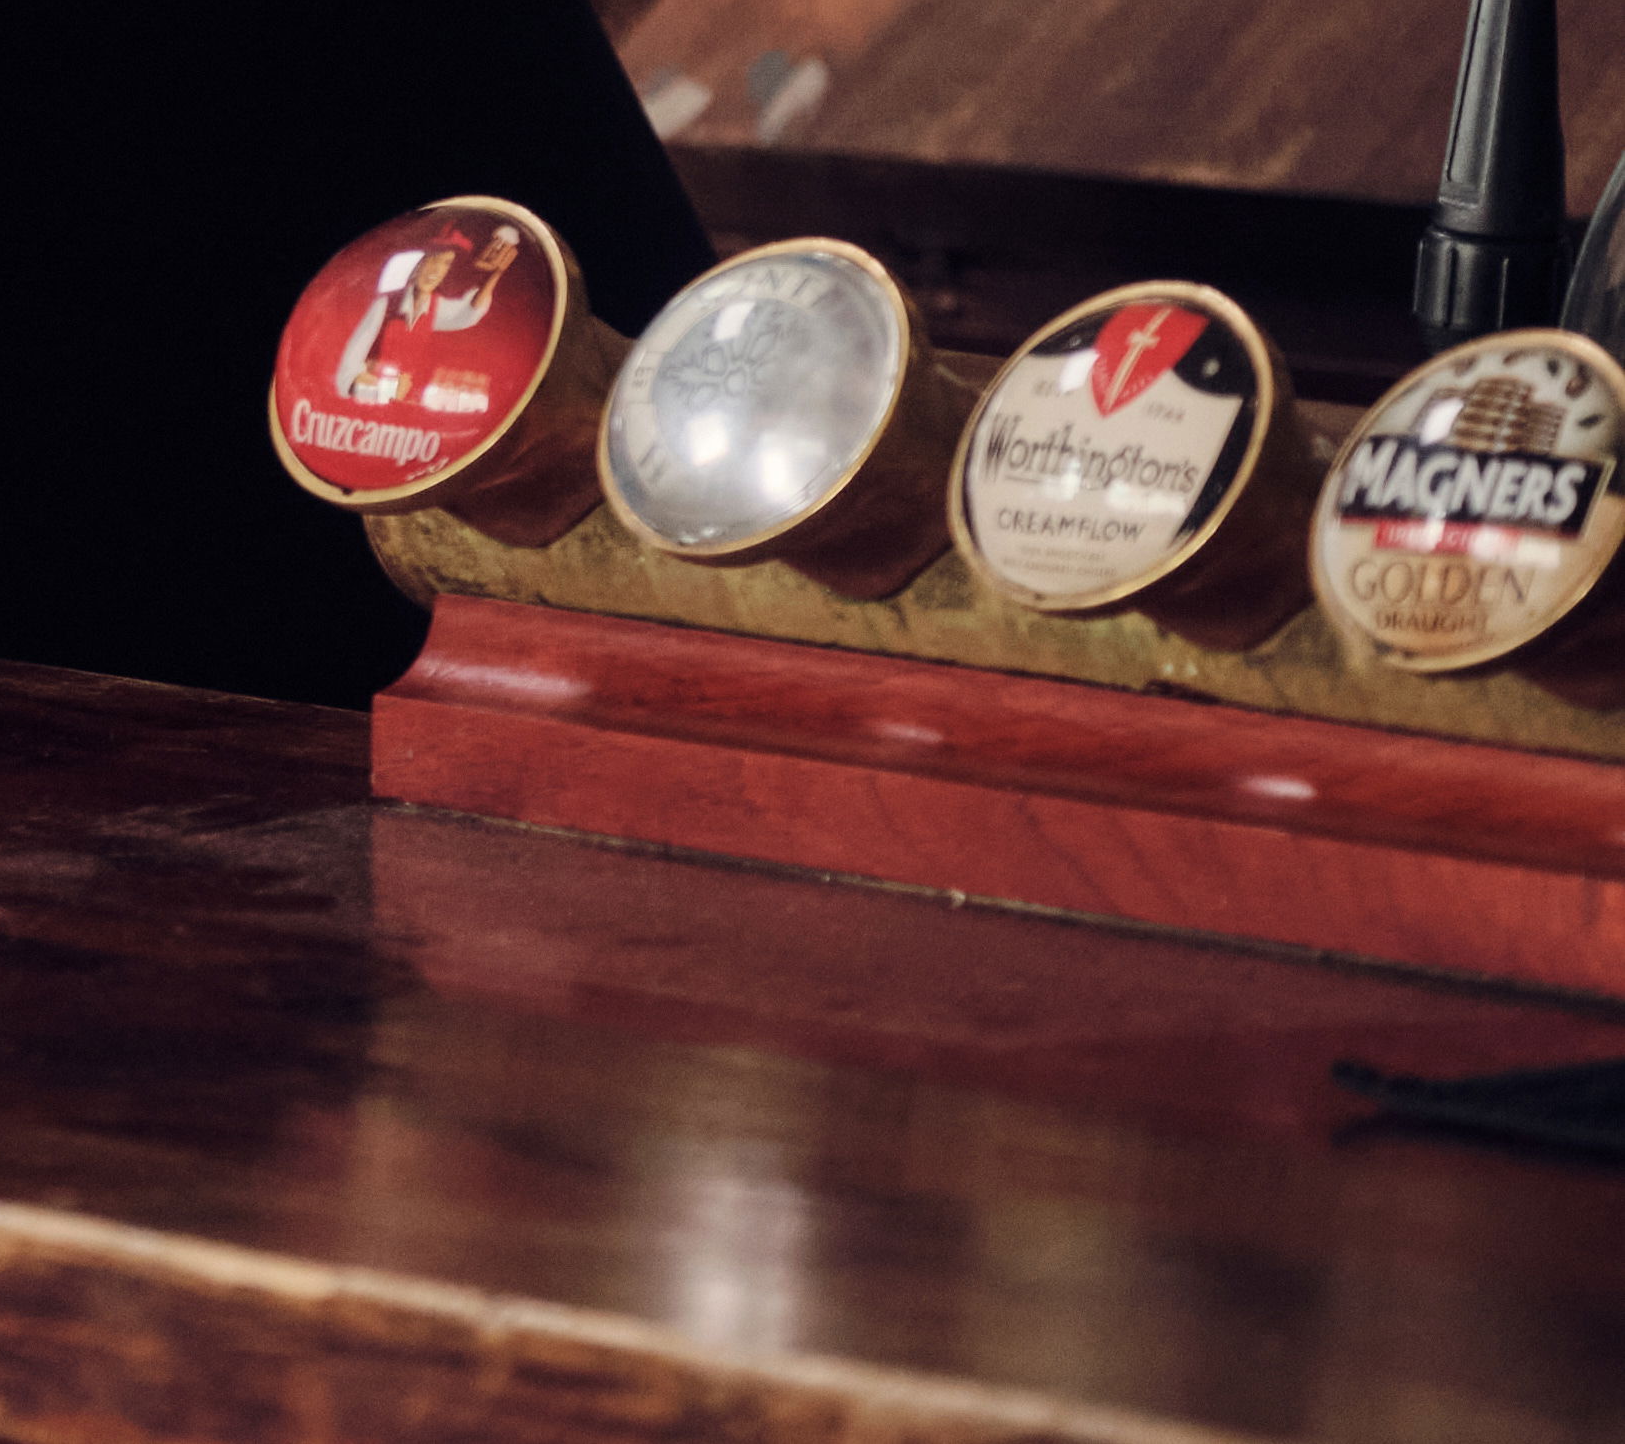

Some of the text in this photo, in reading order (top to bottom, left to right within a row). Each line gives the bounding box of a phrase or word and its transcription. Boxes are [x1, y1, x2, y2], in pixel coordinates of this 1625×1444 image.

[292, 399, 441, 466] Cruzcampo
[984, 414, 1200, 493] Worthington's
[1342, 438, 1587, 525] MAGNERS
[997, 508, 1147, 542] CREAMFLOW
[1351, 561, 1536, 603] GOLDEN
